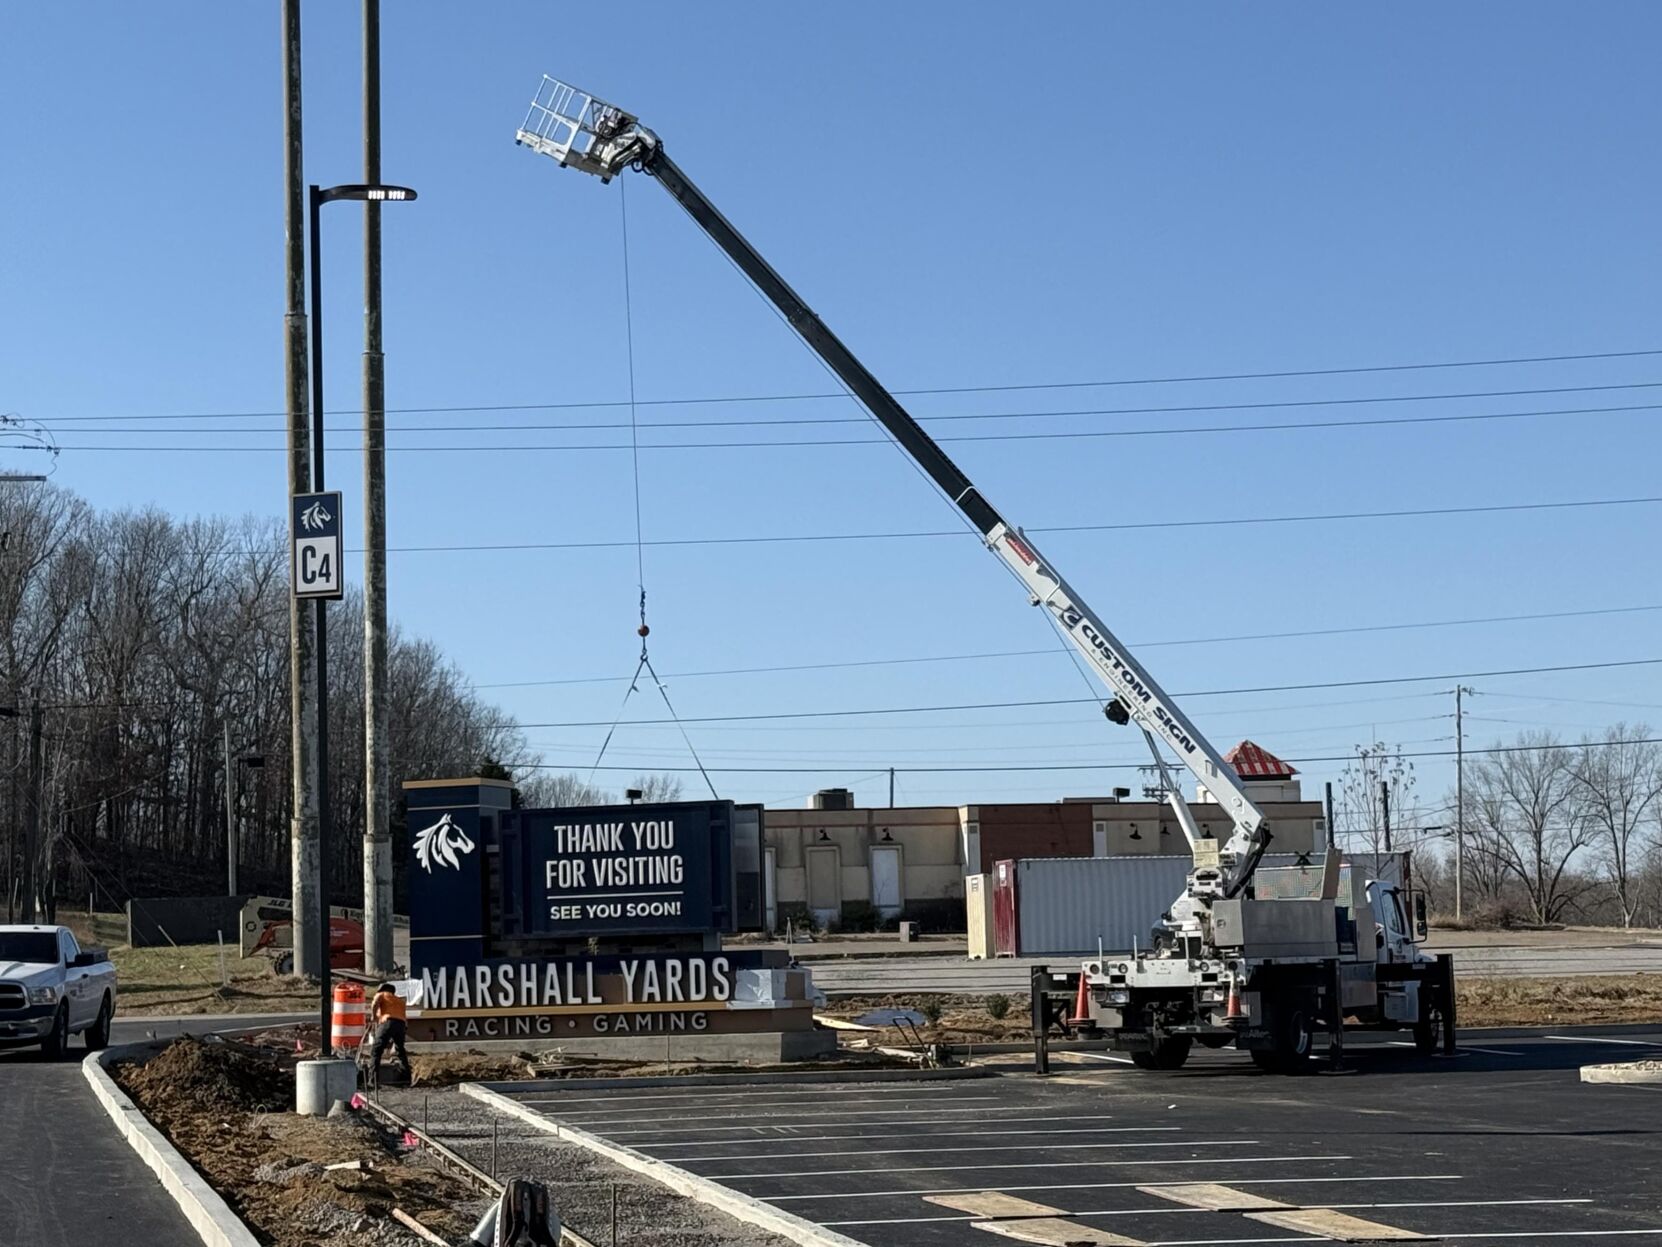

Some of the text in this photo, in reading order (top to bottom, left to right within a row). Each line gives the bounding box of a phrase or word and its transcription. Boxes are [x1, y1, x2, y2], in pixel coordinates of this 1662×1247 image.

[302, 545, 331, 584] C4
[1082, 624, 1196, 754] CUSTOM SIGN
[554, 820, 674, 853] THANK YOU
[546, 855, 683, 889] FOR VISITING
[550, 901, 681, 920] SEE YOU SOON!
[422, 957, 730, 1009] MARSHALL YARDS
[446, 1011, 707, 1036] RACING GAMING
